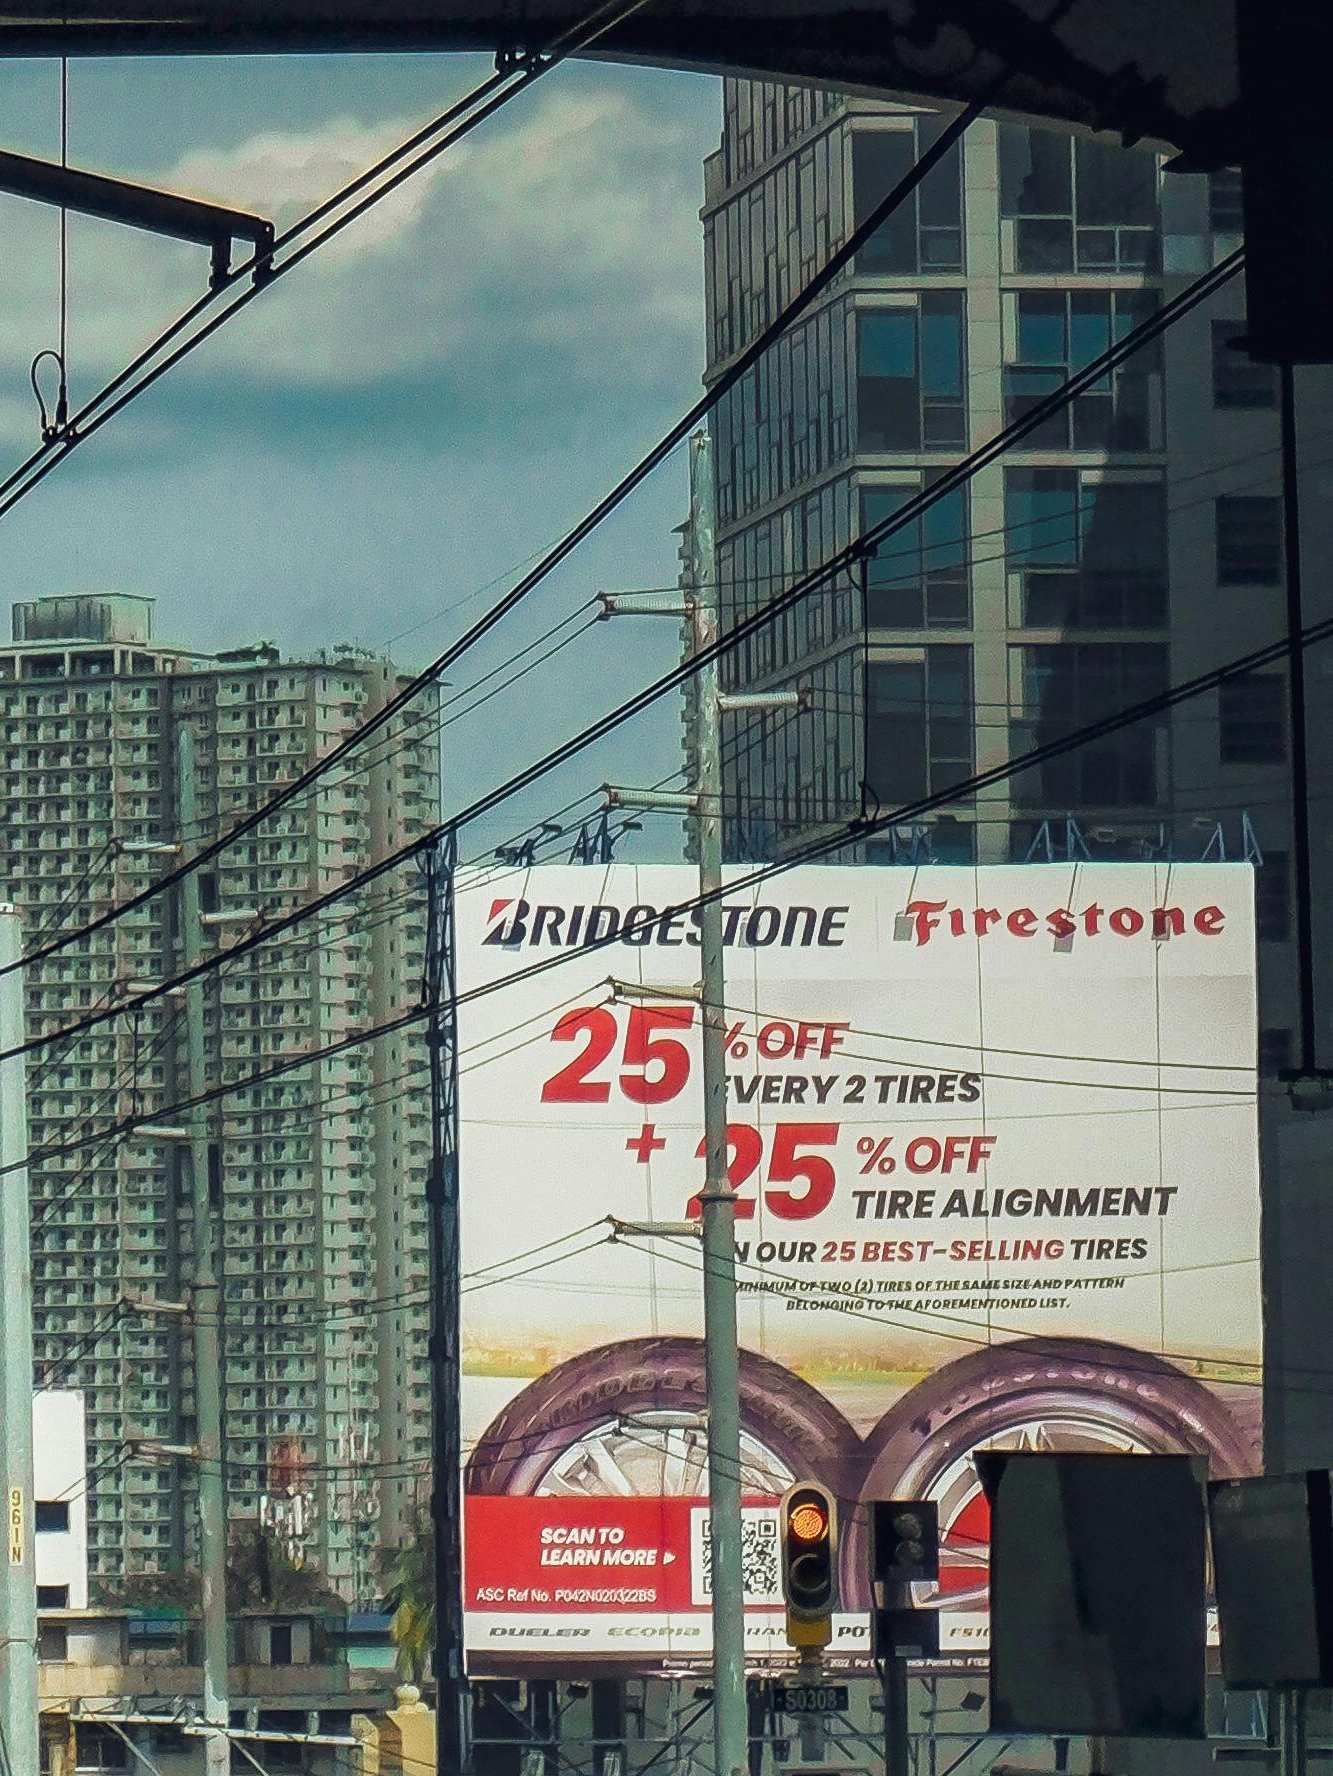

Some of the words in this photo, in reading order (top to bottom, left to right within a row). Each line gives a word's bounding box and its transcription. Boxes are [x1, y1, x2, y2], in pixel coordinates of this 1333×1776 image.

[481, 898, 850, 947] BRIDGESTONE
[906, 900, 1226, 946] Firestone
[540, 1006, 694, 1104] 25
[757, 1021, 850, 1061] OFF
[844, 1075, 865, 1104] 2
[874, 1073, 982, 1104] TIRES
[685, 1122, 840, 1222] 25
[857, 1136, 896, 1175] %
[905, 1135, 997, 1175] OFF
[852, 1190, 937, 1220] TIRE
[940, 1187, 1179, 1219] ALIGNMENT
[756, 1241, 817, 1263] OUR
[821, 1241, 857, 1263] 25
[863, 1239, 1064, 1263] BEST-SELLING
[1070, 1238, 1148, 1260] TIRES
[855, 1279, 874, 1293] (2)
[877, 1280, 912, 1292] TIRES
[915, 1280, 932, 1291] OF
[936, 1280, 960, 1291] THE
[962, 1279, 1001, 1291] SAME
[1003, 1279, 1031, 1290] SIZE
[1033, 1278, 1064, 1290] AND
[1065, 1278, 1126, 1290] PATTERN
[786, 1299, 864, 1311] BELONGING
[869, 1299, 885, 1311] TO
[914, 1298, 1038, 1310] AFOREMENTIONED
[1040, 1297, 1071, 1309] LIST.
[540, 1527, 595, 1544] SCAN
[598, 1527, 625, 1544] TO
[540, 1549, 600, 1566] LEARN
[603, 1549, 658, 1566] MORE
[476, 1587, 504, 1602] ASC
[507, 1587, 529, 1602] Ref
[531, 1588, 551, 1602] No.
[489, 1627, 591, 1636] DUELER
